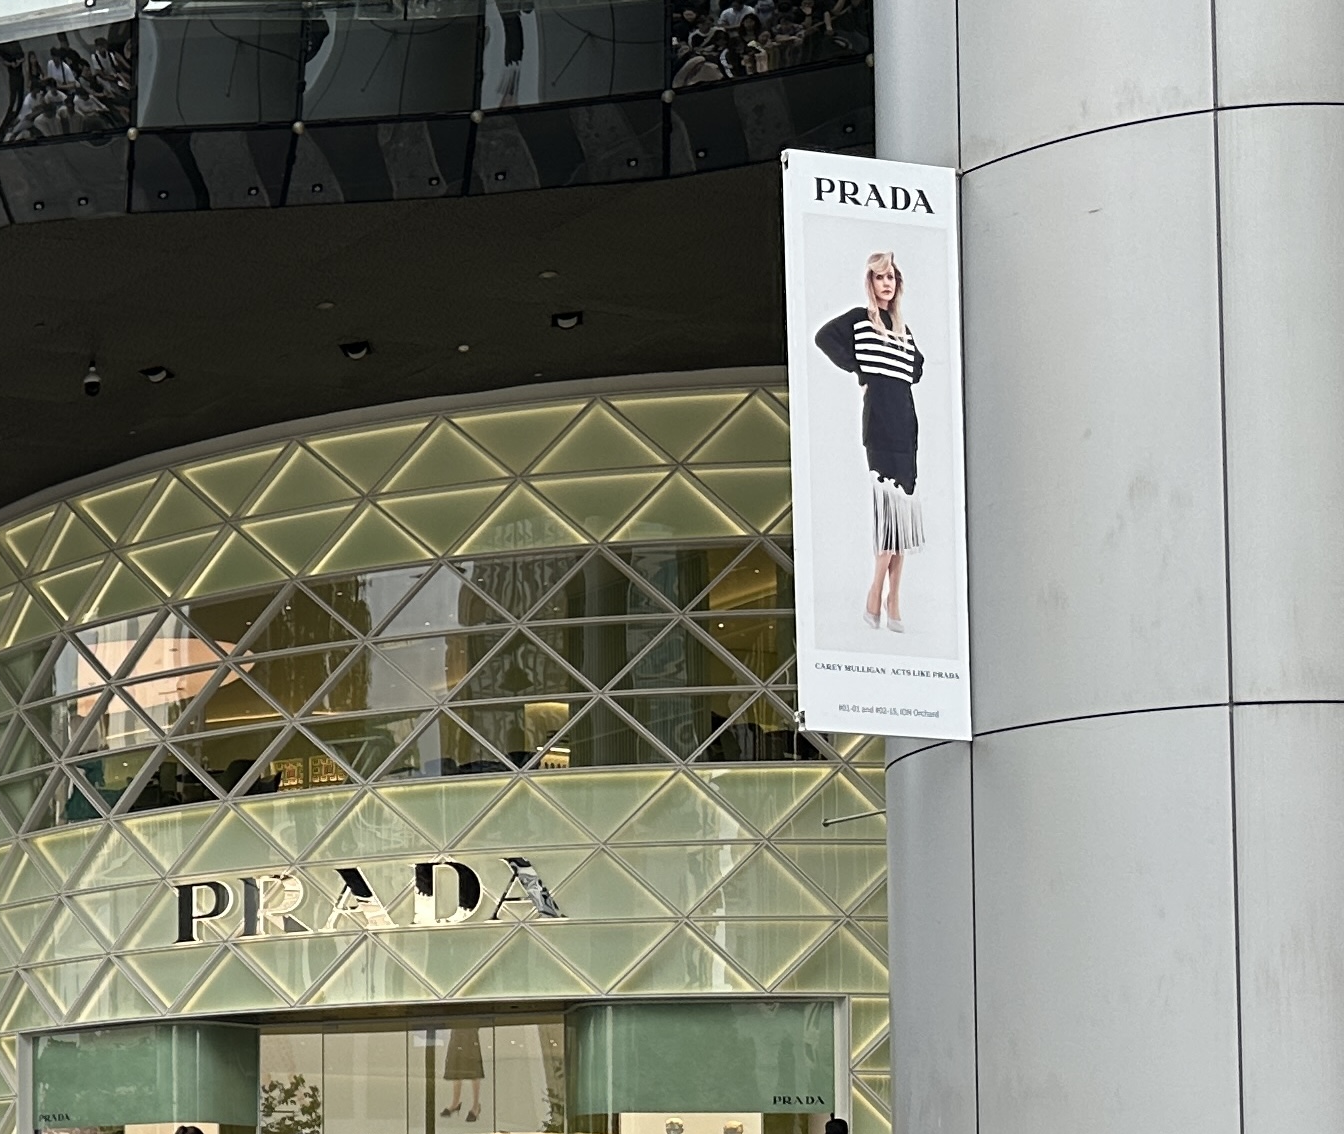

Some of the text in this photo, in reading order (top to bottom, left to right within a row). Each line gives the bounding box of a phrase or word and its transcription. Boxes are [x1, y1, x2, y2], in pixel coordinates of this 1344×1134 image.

[814, 176, 935, 214] PRADA
[815, 661, 960, 680] CAREY MULLIGAN ACTS LIKE PRADA
[172, 856, 569, 944] PRADA
[773, 1095, 825, 1105] PRADA
[38, 1113, 70, 1122] PRADA
